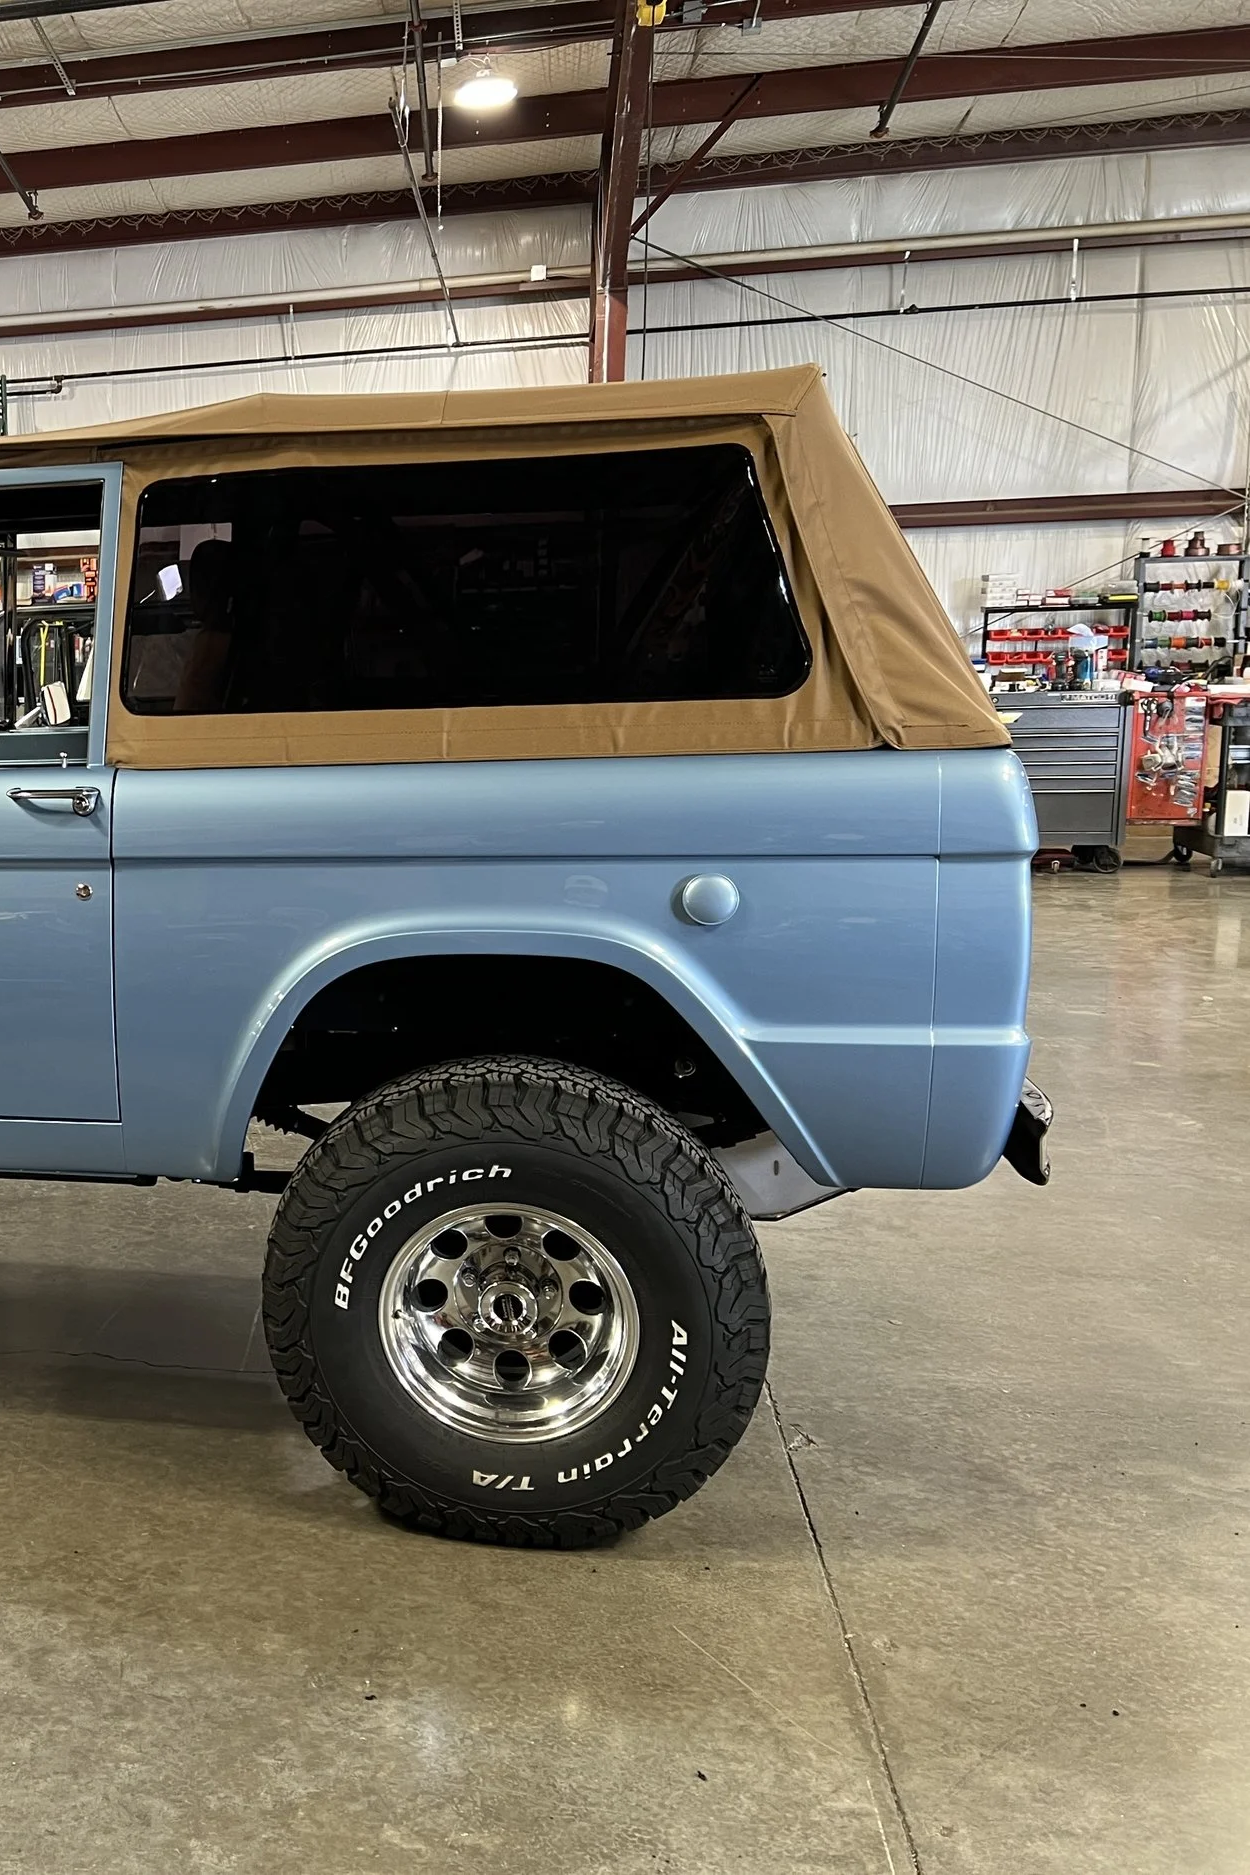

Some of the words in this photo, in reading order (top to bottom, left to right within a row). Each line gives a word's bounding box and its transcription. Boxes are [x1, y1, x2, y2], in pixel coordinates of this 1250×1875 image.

[334, 1164, 512, 1310] BFGoodrich
[557, 1319, 689, 1484] All-Terrain
[472, 1469, 535, 1491] T/A
